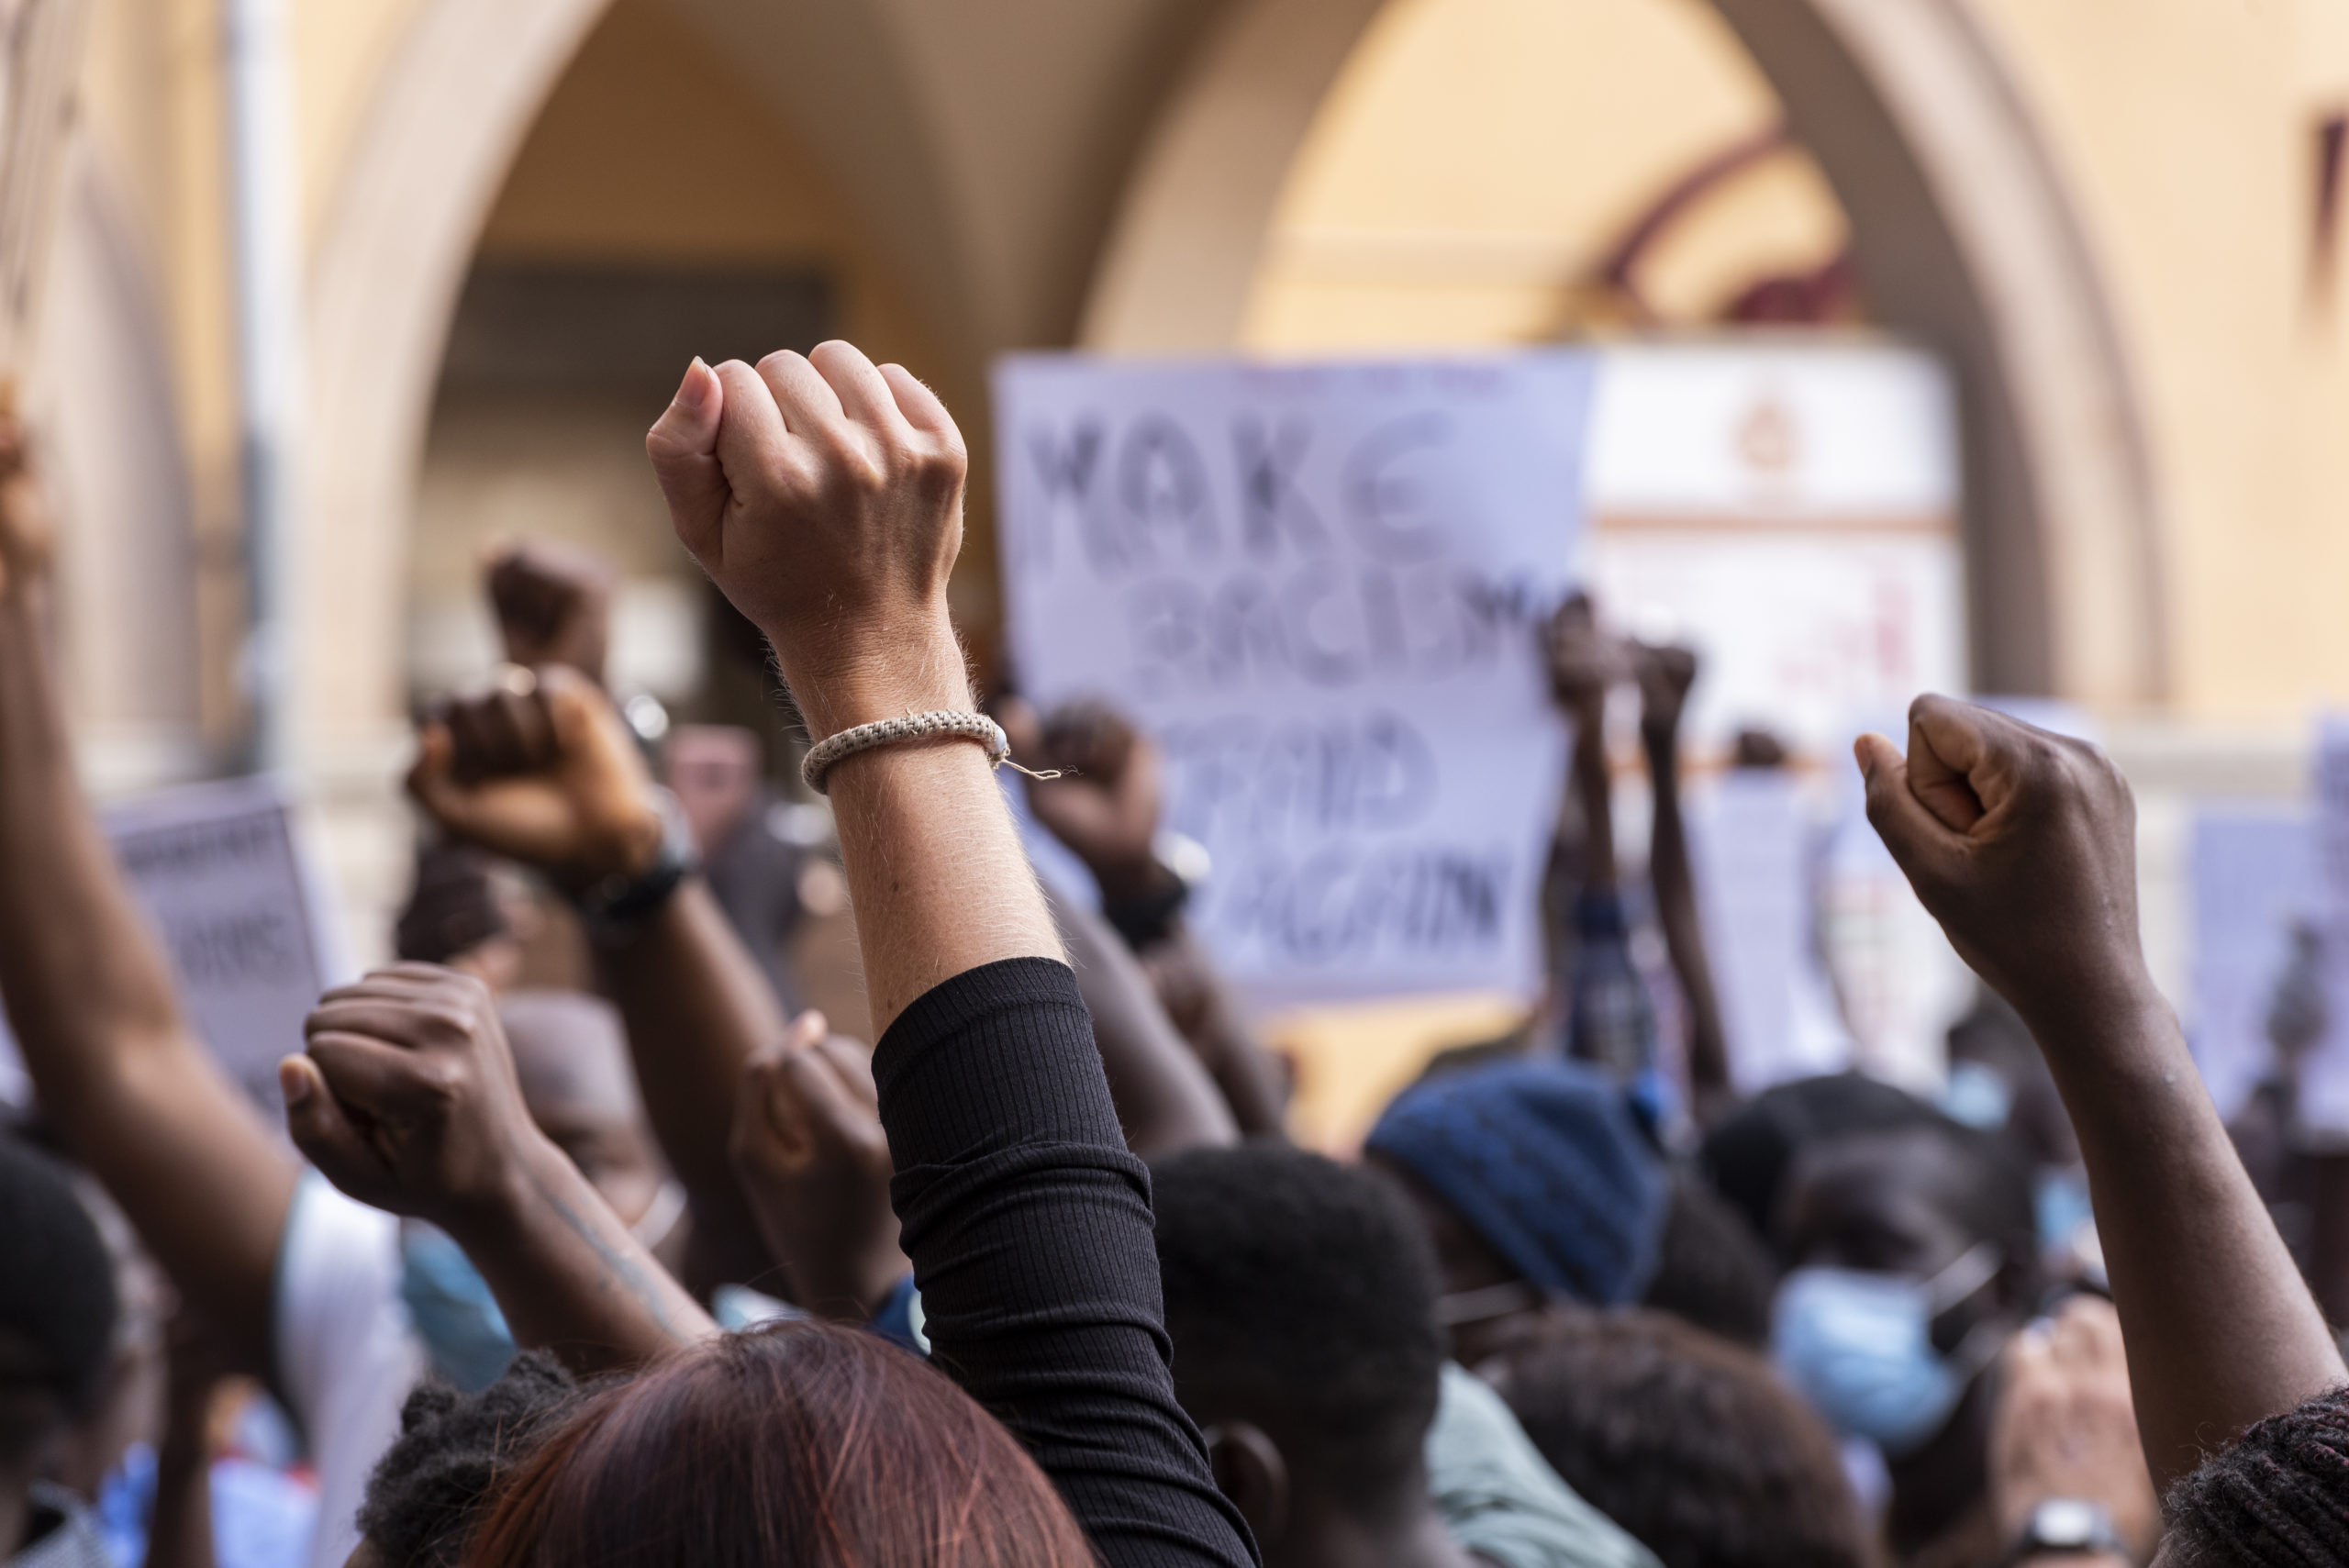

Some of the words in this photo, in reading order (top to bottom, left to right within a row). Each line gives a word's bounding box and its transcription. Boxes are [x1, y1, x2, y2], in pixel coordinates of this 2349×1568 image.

[1019, 407, 1459, 585] MAKE
[1119, 562, 1547, 692] RACISM
[1225, 837, 1516, 969] AGAIN
